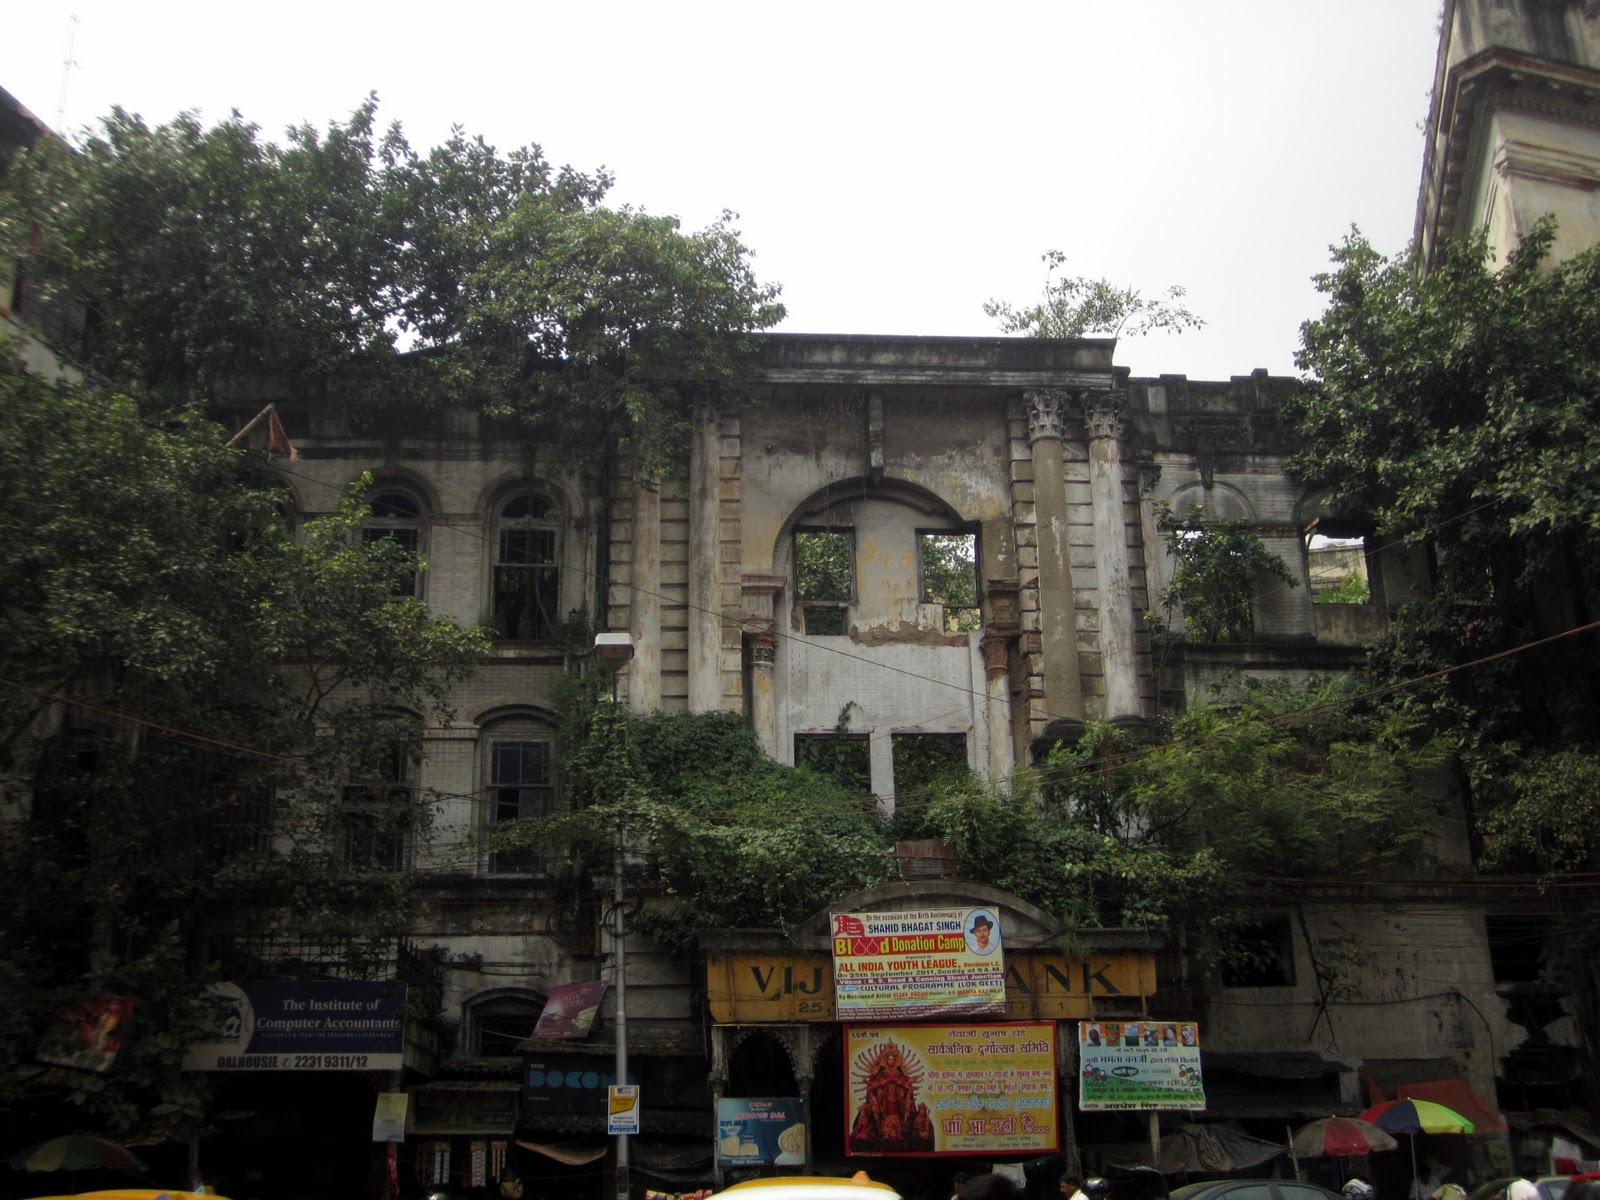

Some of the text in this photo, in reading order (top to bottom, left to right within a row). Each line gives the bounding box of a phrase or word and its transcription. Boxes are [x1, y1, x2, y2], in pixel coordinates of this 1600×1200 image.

[918, 912, 930, 920] Birth
[930, 911, 957, 920] Anniversary
[868, 924, 899, 934] SHAHID
[902, 922, 934, 932] BHAGAT
[936, 921, 961, 932] SINGH
[892, 936, 936, 952] Donation
[938, 934, 965, 952] Camp
[839, 964, 857, 972] ALL
[858, 962, 884, 972] INDIA
[886, 960, 919, 970] YOUTH
[921, 959, 960, 970] LEAGUE,
[751, 963, 1120, 994] VIJ ANK
[870, 970, 913, 978] September
[902, 982, 954, 990] PROGRAMME
[282, 998, 381, 1010] The Institute of
[256, 1018, 400, 1030] Computer Accountants
[926, 1040, 1050, 1056] सार्वजनिक दुर्गोत्सव समिति
[218, 1056, 278, 1068] DALHOUSIE
[1125, 1054, 1148, 1063] बनर्जी
[990, 1116, 1016, 1134] रही
